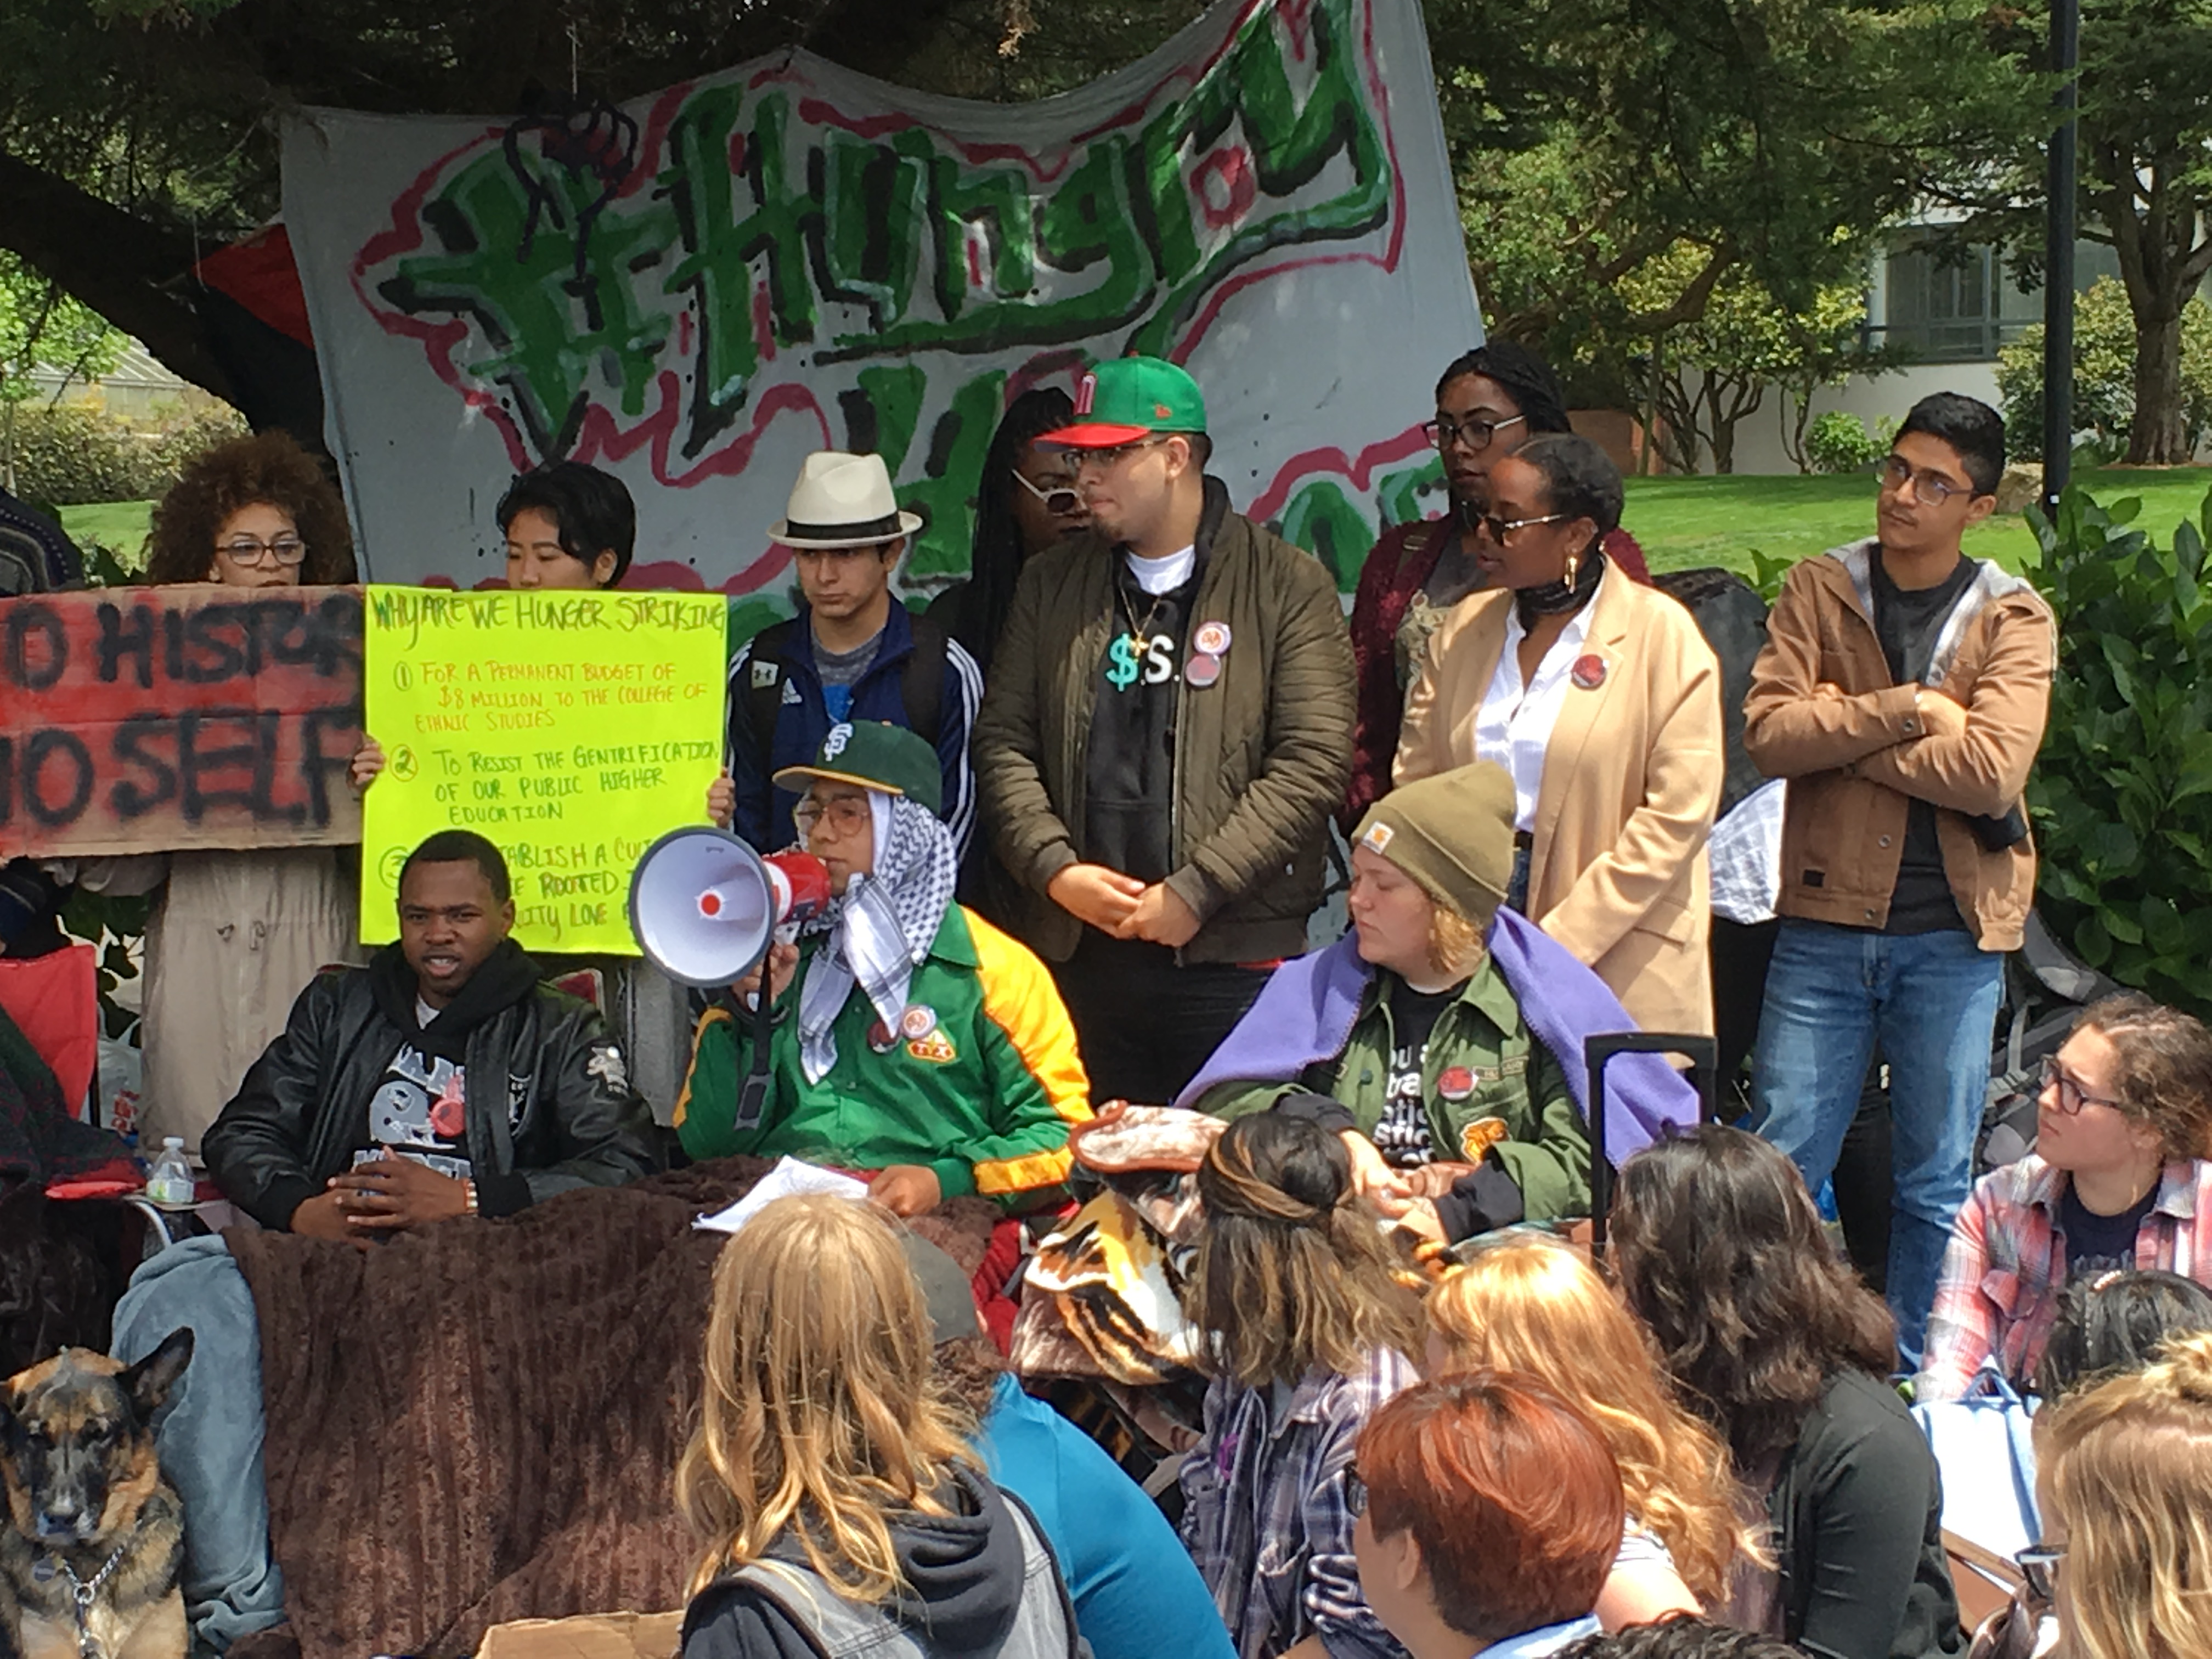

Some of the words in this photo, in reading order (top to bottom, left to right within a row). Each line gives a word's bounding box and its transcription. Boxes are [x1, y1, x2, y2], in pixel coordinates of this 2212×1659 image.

[369, 591, 419, 652] WHY
[421, 594, 466, 629] ARE
[466, 595, 510, 629] WE
[516, 595, 612, 631] HUNGER
[615, 596, 725, 639] STRIKING
[419, 662, 460, 685] FOR
[467, 663, 481, 682] A
[582, 662, 645, 682] BUDGET
[652, 662, 676, 681] OF
[471, 690, 542, 708] MILLION
[555, 691, 574, 707] TO
[582, 689, 610, 707] THE
[617, 685, 675, 705] COLLEGE
[683, 682, 708, 699] OF
[415, 714, 470, 733] ETHNIC
[486, 708, 555, 732] STUDIES
[0, 725, 95, 827] O
[112, 706, 364, 830] SELF
[467, 751, 523, 773] RESIST
[532, 751, 565, 771] THE
[573, 741, 720, 768] GENTRIFICATION
[435, 782, 460, 803] OF
[472, 777, 506, 801] OUR
[519, 775, 584, 800] PUBLIC
[599, 767, 668, 793] HIGHER
[449, 801, 563, 826] EDUCATION
[595, 843, 608, 867] A
[538, 869, 620, 900] ROOTED
[569, 902, 608, 928] LOVE
